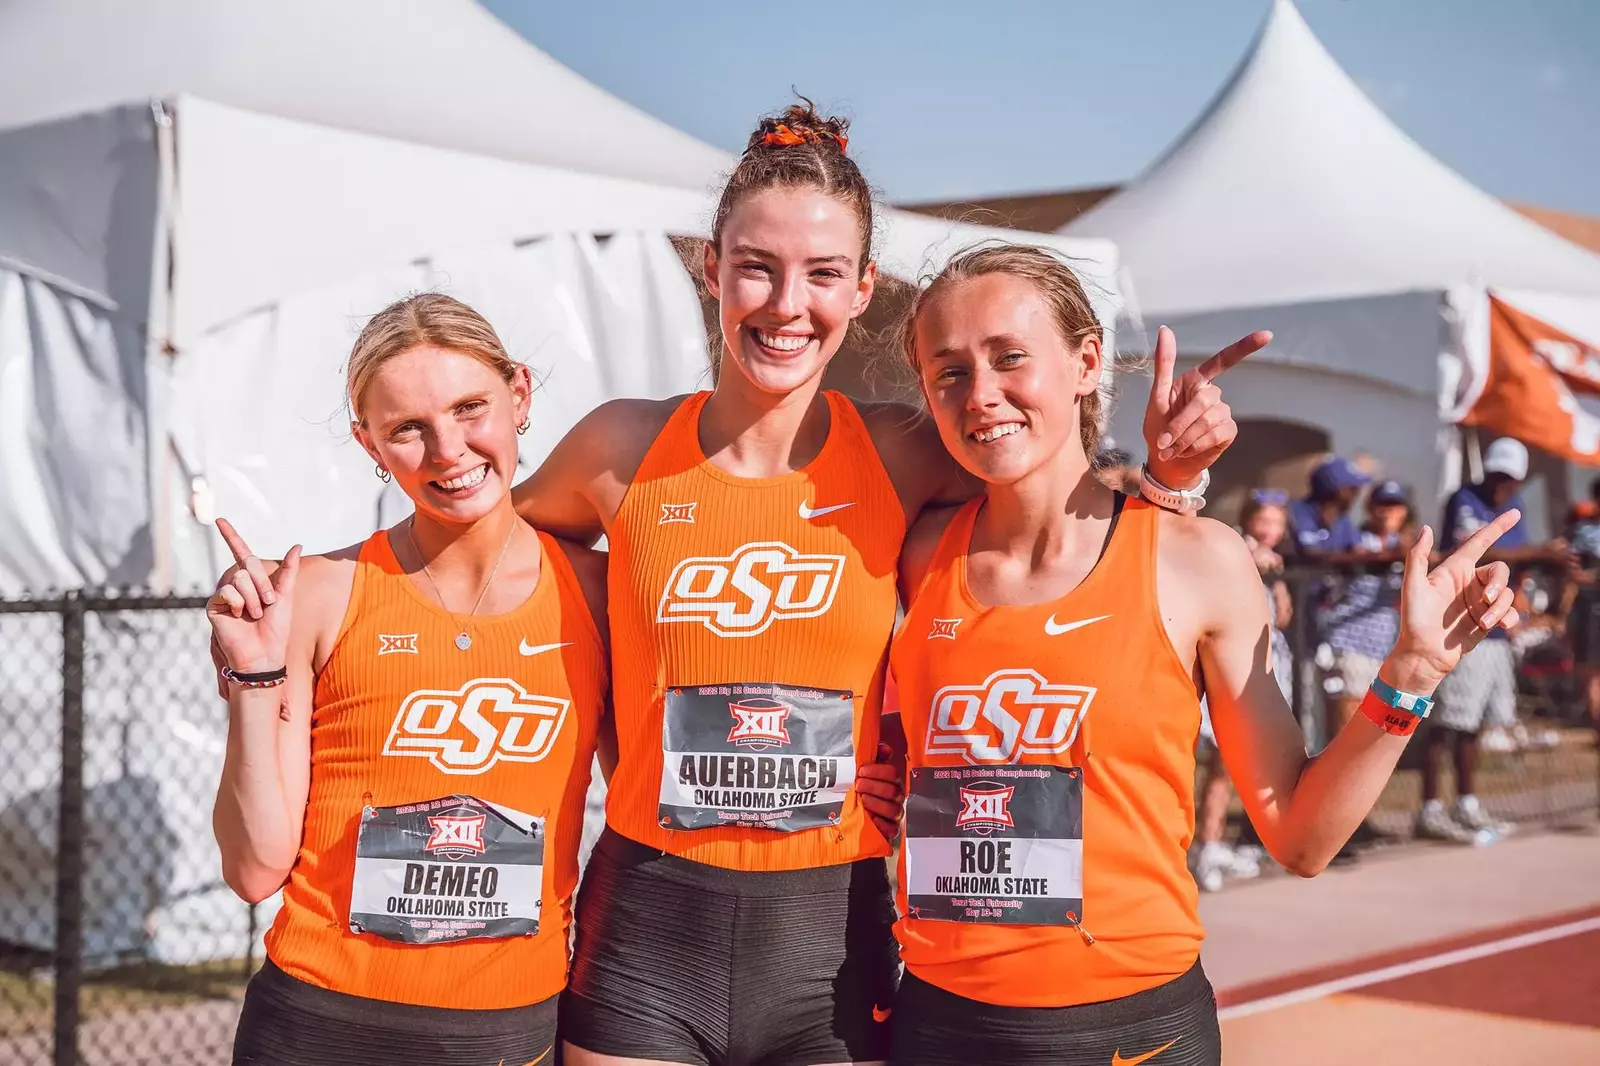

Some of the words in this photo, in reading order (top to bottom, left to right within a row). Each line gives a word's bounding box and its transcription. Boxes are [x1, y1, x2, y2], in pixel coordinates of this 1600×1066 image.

[661, 504, 694, 522] XII
[664, 546, 837, 631] OSU
[381, 635, 416, 652] XII
[699, 687, 718, 695] 2022
[719, 687, 731, 696] Big
[743, 687, 772, 695] Outdoor
[391, 683, 561, 769] OSU
[732, 708, 787, 739] XII
[930, 674, 1087, 760] OSU
[679, 755, 837, 790] AUERBACH
[996, 769, 1051, 778] Championships
[694, 789, 775, 808] OKLAHOMA
[779, 790, 818, 808] STATE
[960, 790, 1011, 822] XII
[432, 818, 481, 848] XII
[960, 840, 1012, 874] ROE
[403, 863, 499, 899] DEMEO
[935, 876, 1000, 894] OKLAHOMA
[1004, 877, 1048, 895] STATE
[387, 896, 465, 917] OKLAHOMA
[468, 901, 508, 917] STATE
